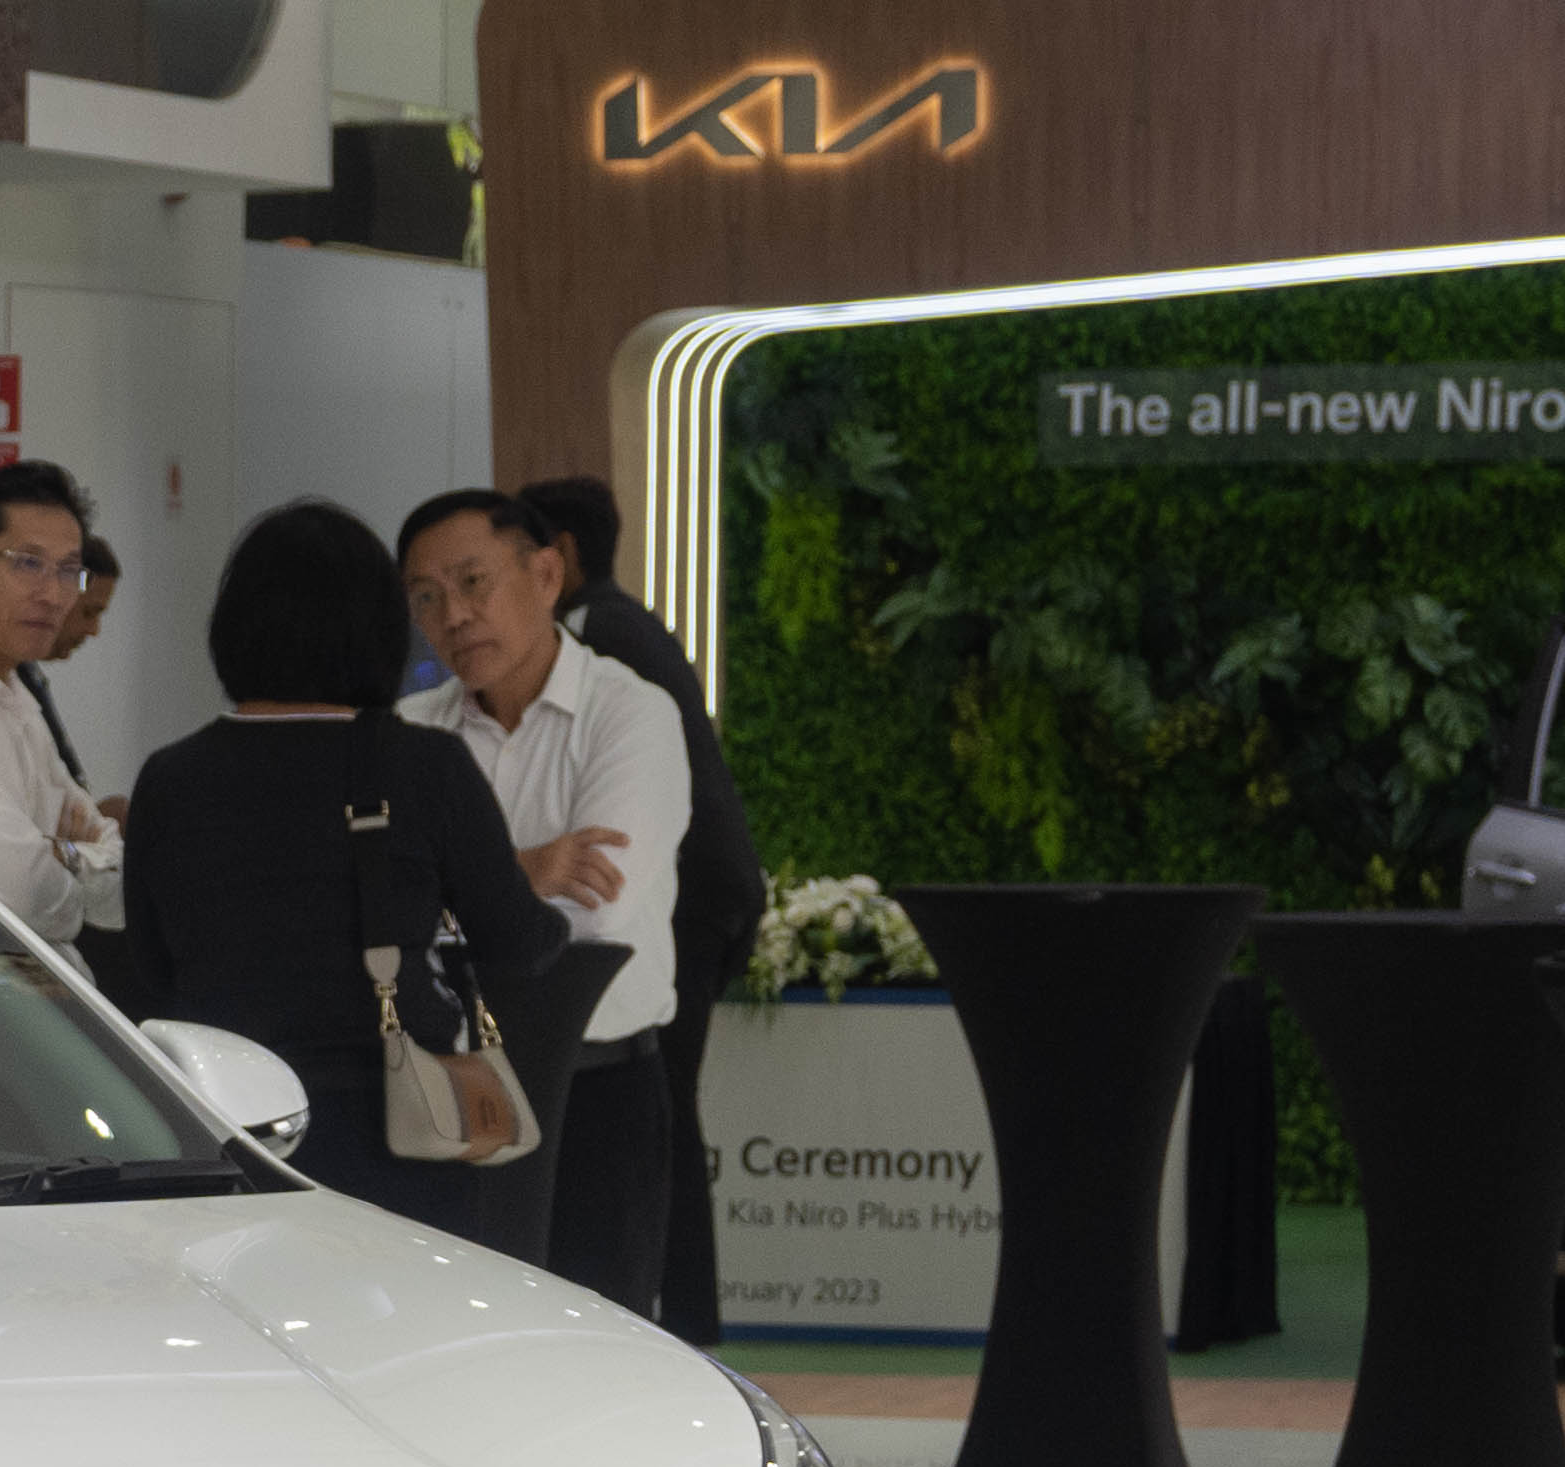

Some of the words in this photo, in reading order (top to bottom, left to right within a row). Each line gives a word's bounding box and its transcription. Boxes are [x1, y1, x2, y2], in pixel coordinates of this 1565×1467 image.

[1060, 383, 1170, 438] The
[1189, 378, 1422, 434] all-new
[1438, 377, 1565, 433] Niro
[741, 1136, 984, 1191] Ceremony
[728, 1199, 774, 1226] Kia
[784, 1201, 849, 1228] Niro
[858, 1202, 920, 1230] Plus
[815, 1278, 881, 1303] 2023
